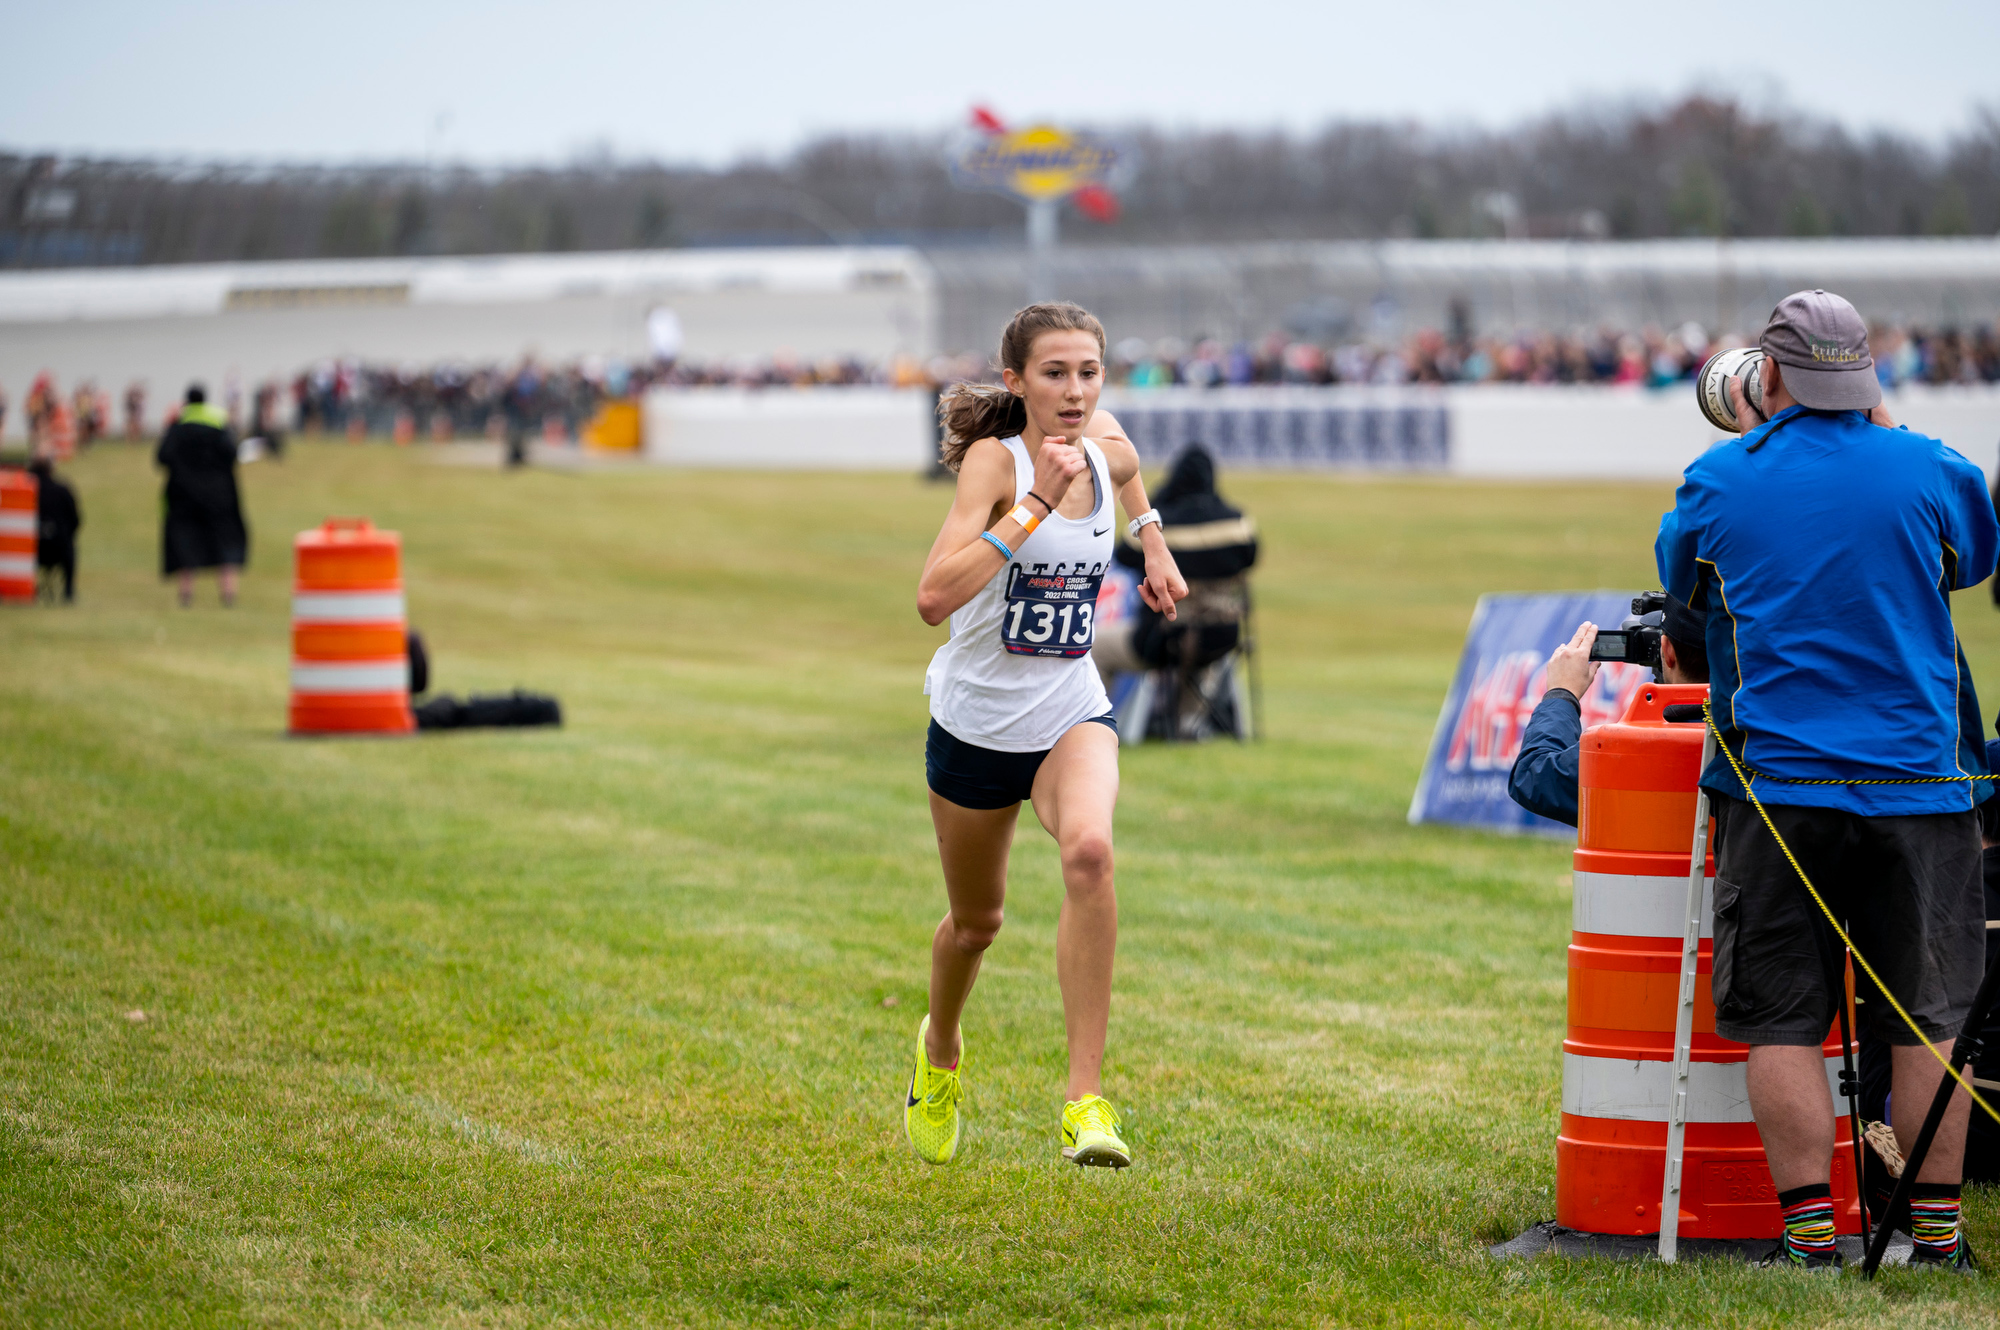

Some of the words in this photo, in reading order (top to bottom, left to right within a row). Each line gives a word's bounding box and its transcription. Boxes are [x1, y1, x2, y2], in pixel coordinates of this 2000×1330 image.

[1044, 591, 1061, 599] 2022
[1061, 591, 1079, 599] FINAL
[1009, 601, 1092, 644] 1313
[1710, 1165, 1752, 1181] FOR
